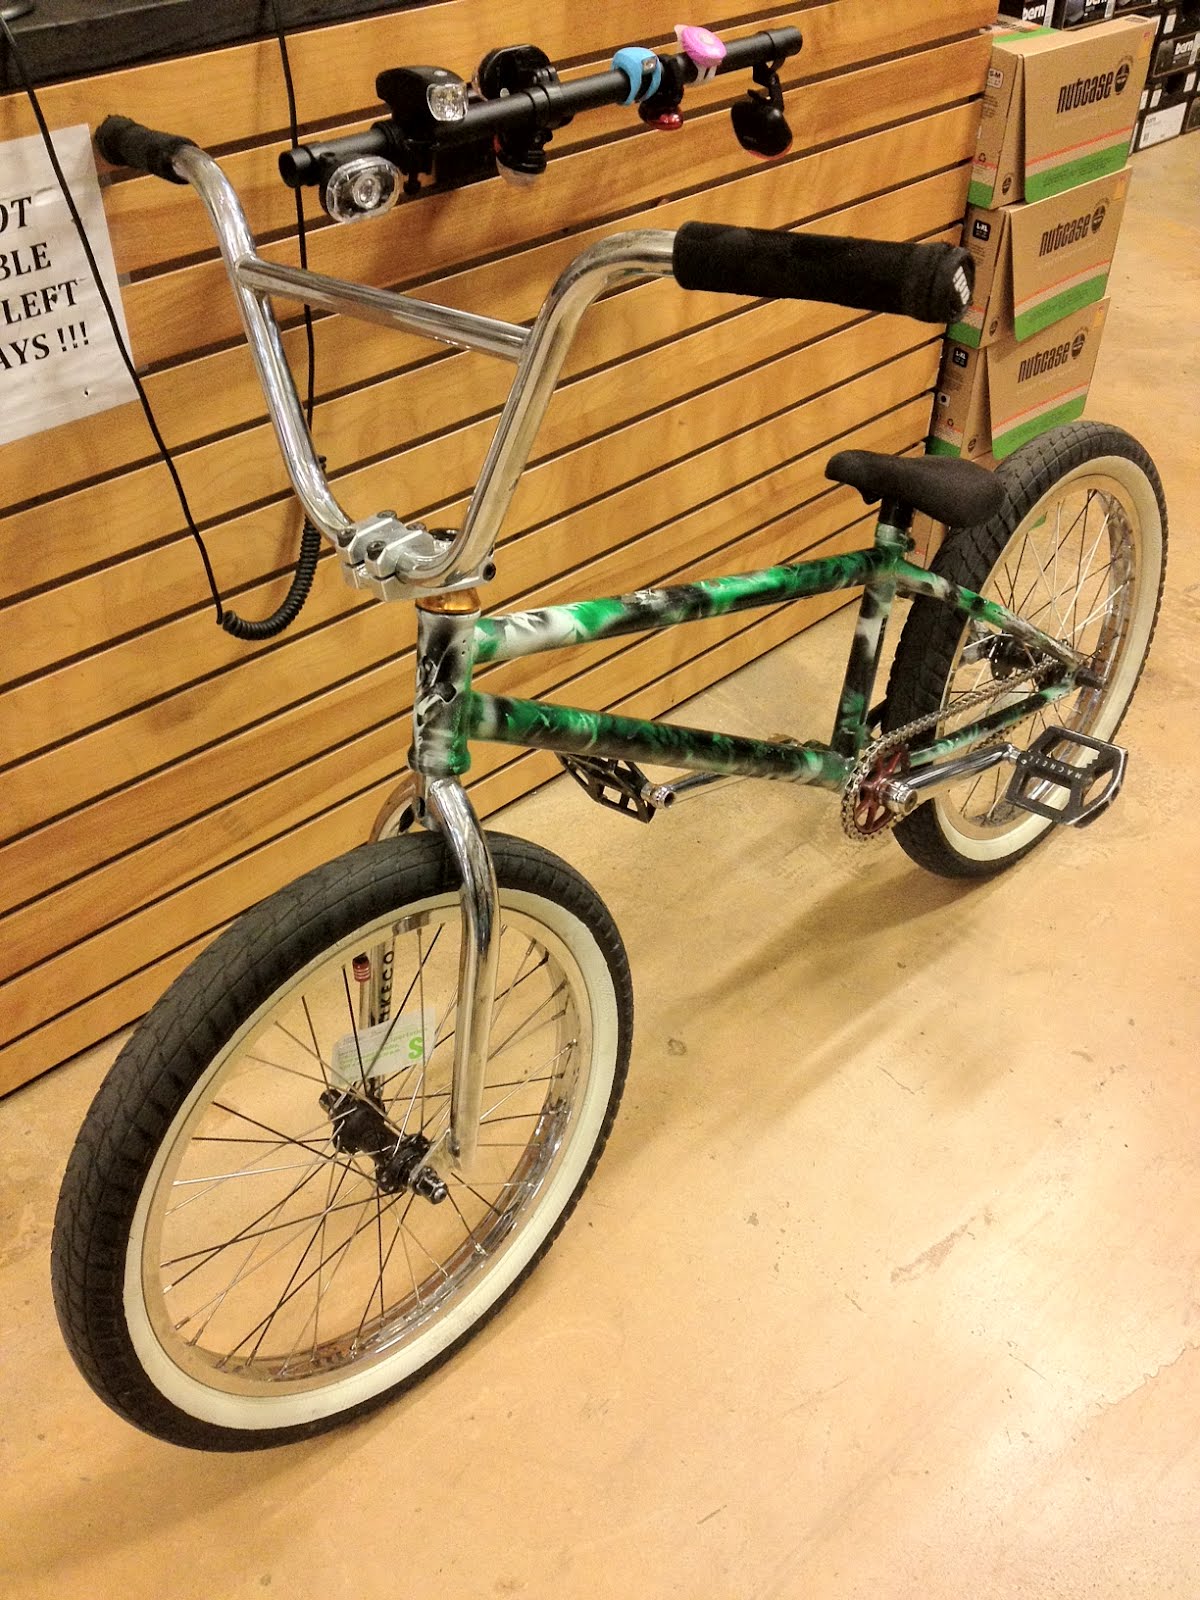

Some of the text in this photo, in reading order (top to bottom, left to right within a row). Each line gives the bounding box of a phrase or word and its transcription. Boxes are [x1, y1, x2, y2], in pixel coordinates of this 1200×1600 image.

[1022, 4, 1045, 20] bern
[1056, 71, 1115, 114] nutcase
[1039, 213, 1092, 257] nutcase
[1, 279, 79, 326] LEFT
[1017, 341, 1071, 384] nutcase
